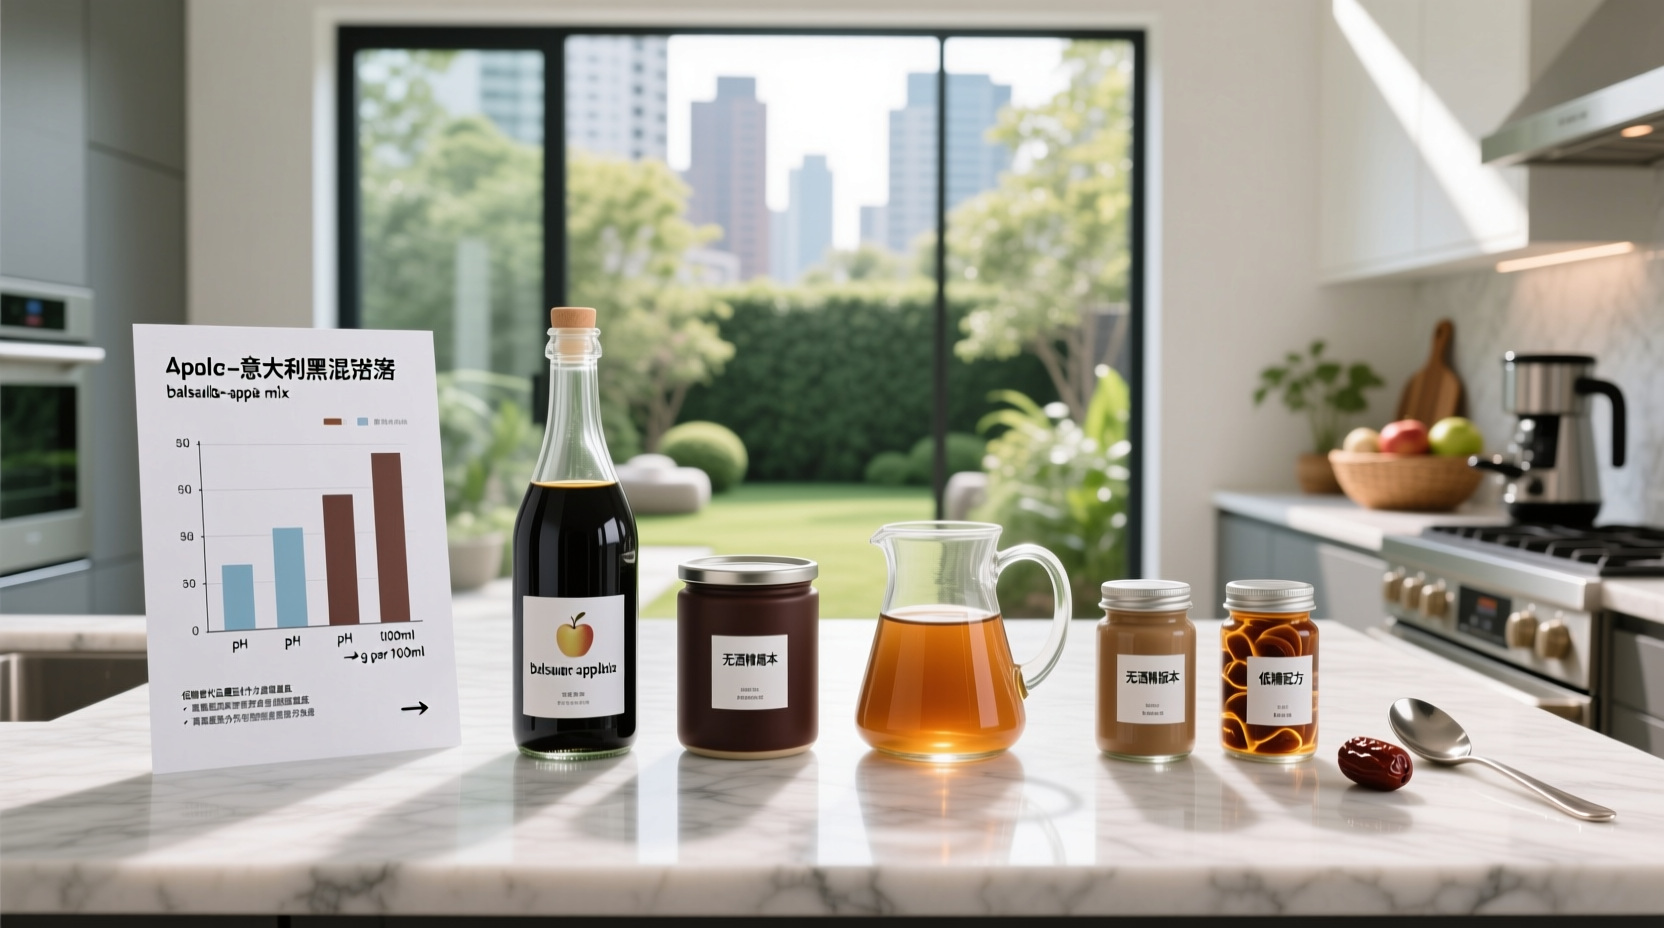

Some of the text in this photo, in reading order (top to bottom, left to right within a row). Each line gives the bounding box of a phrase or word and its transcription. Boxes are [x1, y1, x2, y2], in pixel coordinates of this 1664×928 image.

[192, 626, 200, 636] 0
[232, 638, 248, 653] pH
[284, 635, 301, 650] pH
[337, 633, 353, 647] pH
[391, 645, 425, 660] 100ml
